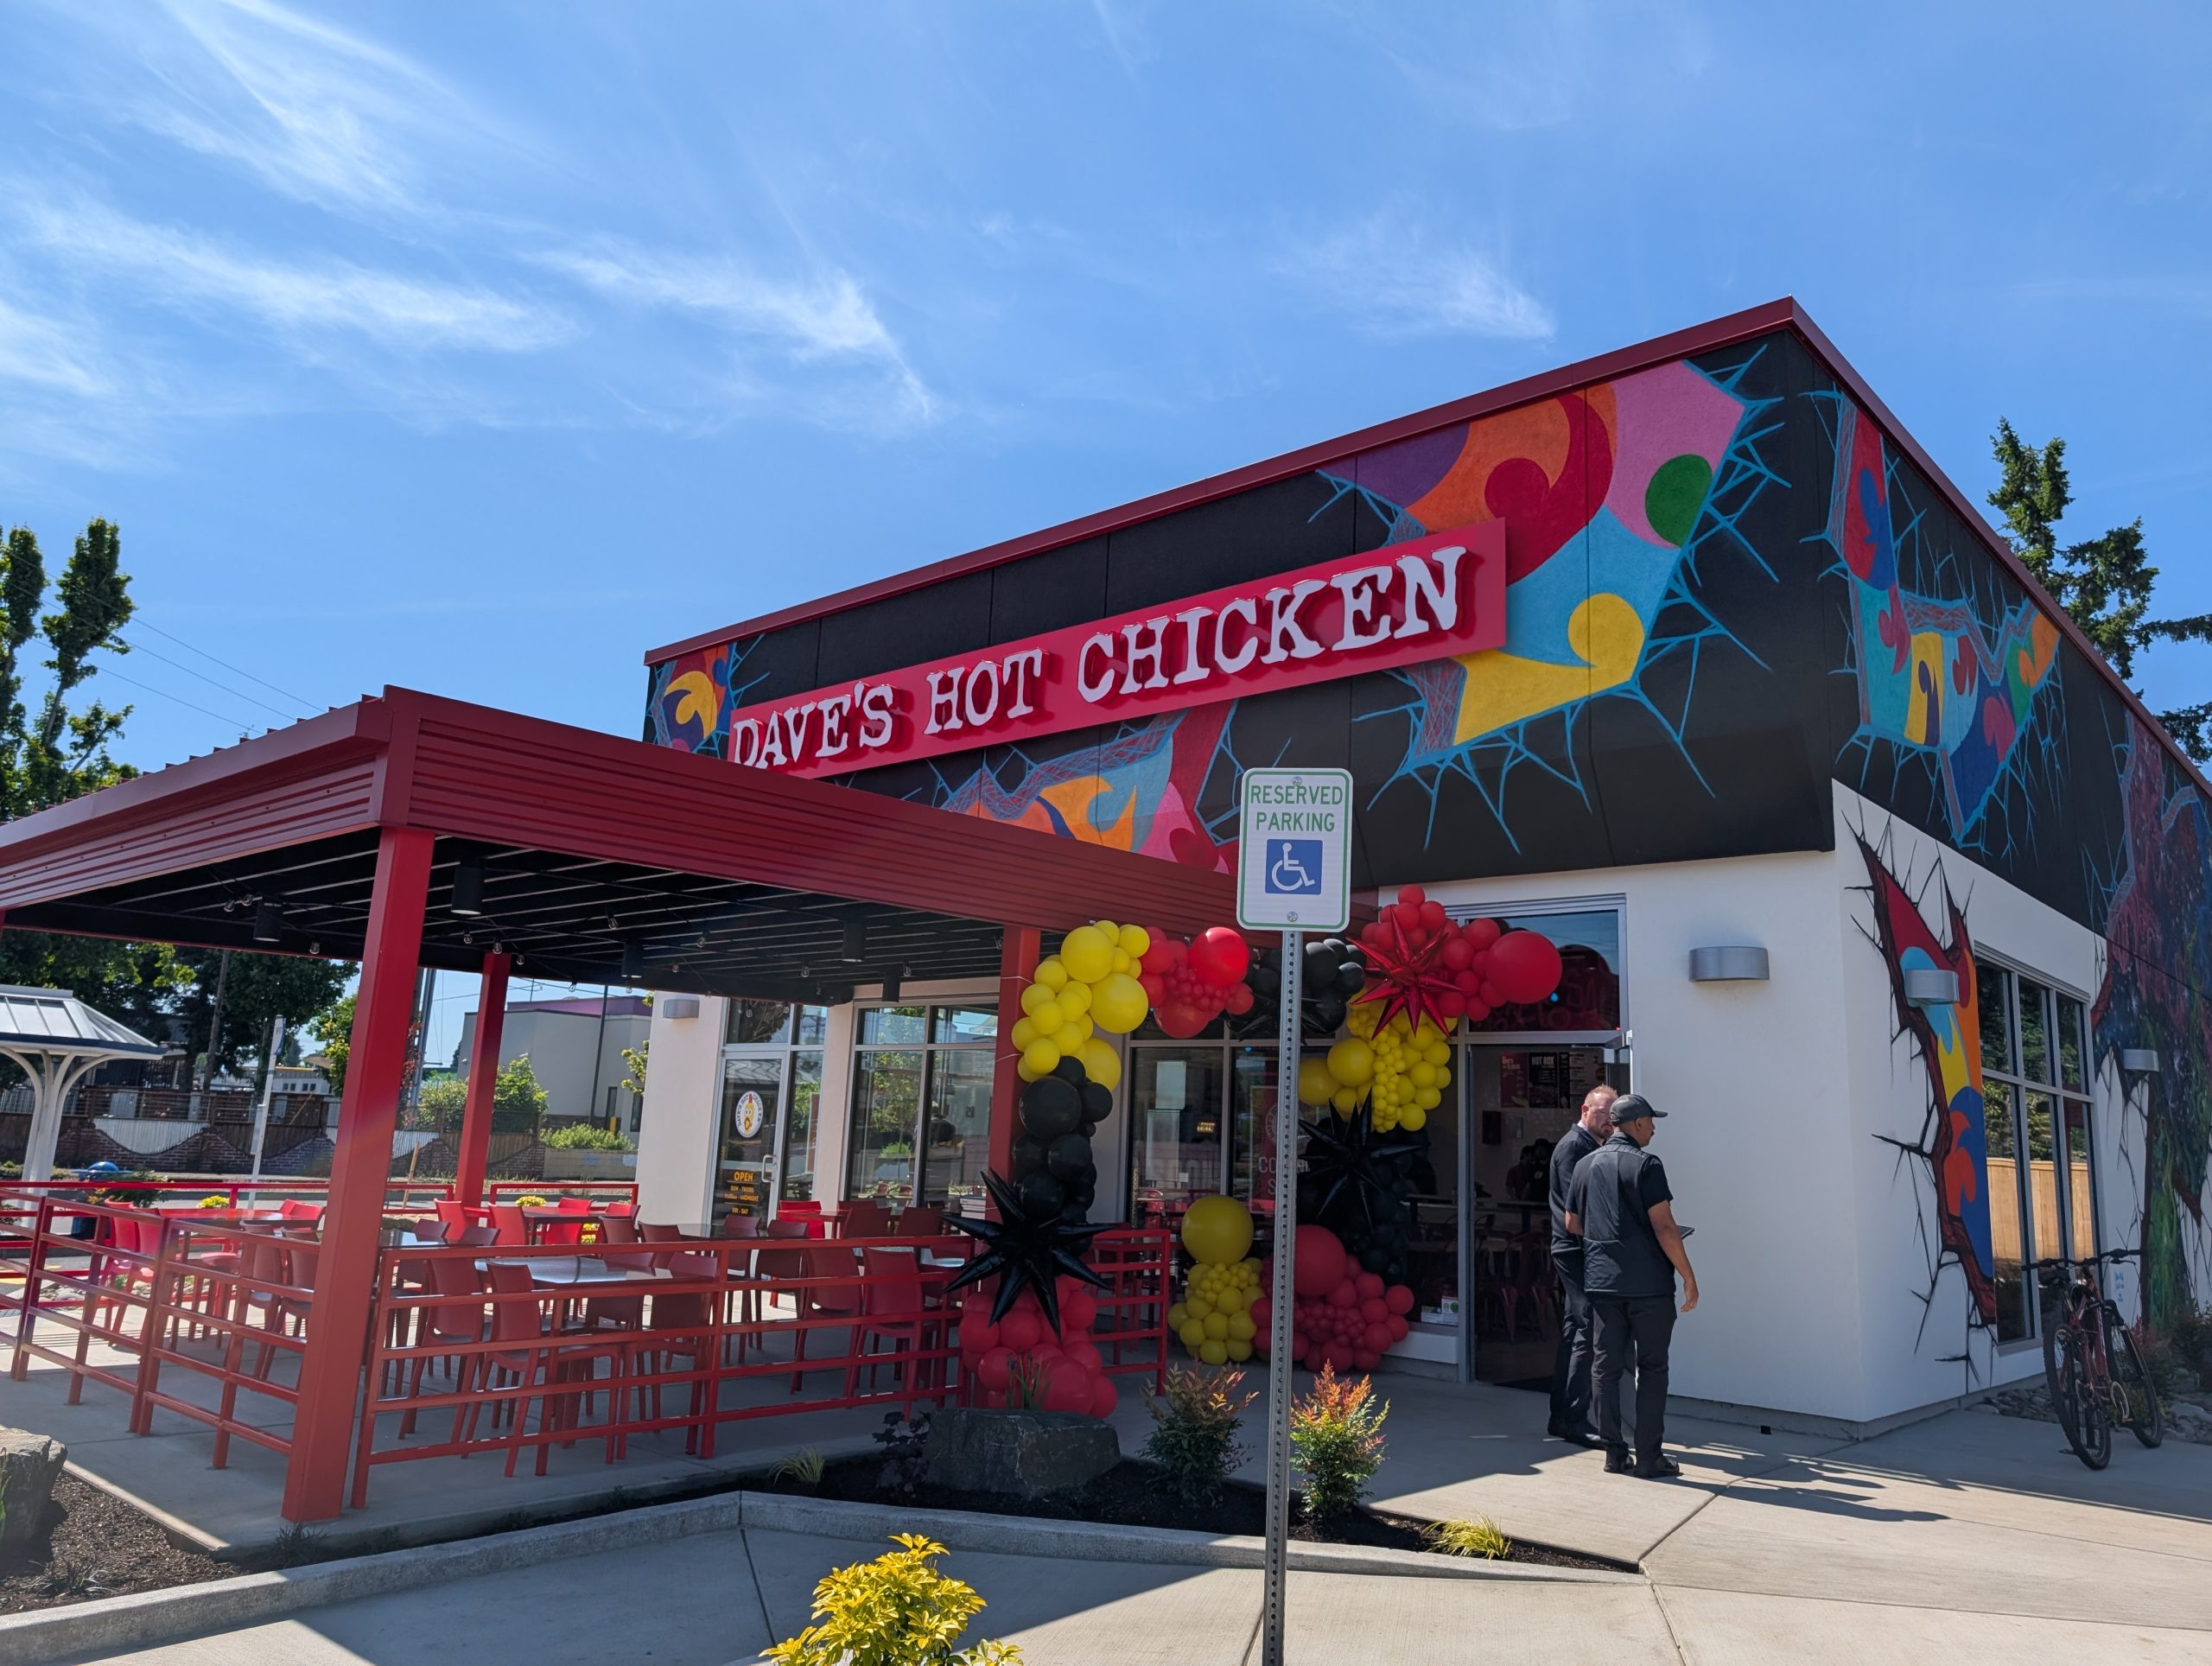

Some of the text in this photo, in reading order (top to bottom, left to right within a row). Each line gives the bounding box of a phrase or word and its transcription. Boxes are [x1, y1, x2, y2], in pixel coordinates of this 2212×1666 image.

[733, 545, 1467, 770] DAVE'S HOT CHICKEN
[1250, 785, 1343, 805] RESERVED
[1255, 811, 1335, 832] PARKING
[734, 1171, 754, 1182] OPEN
